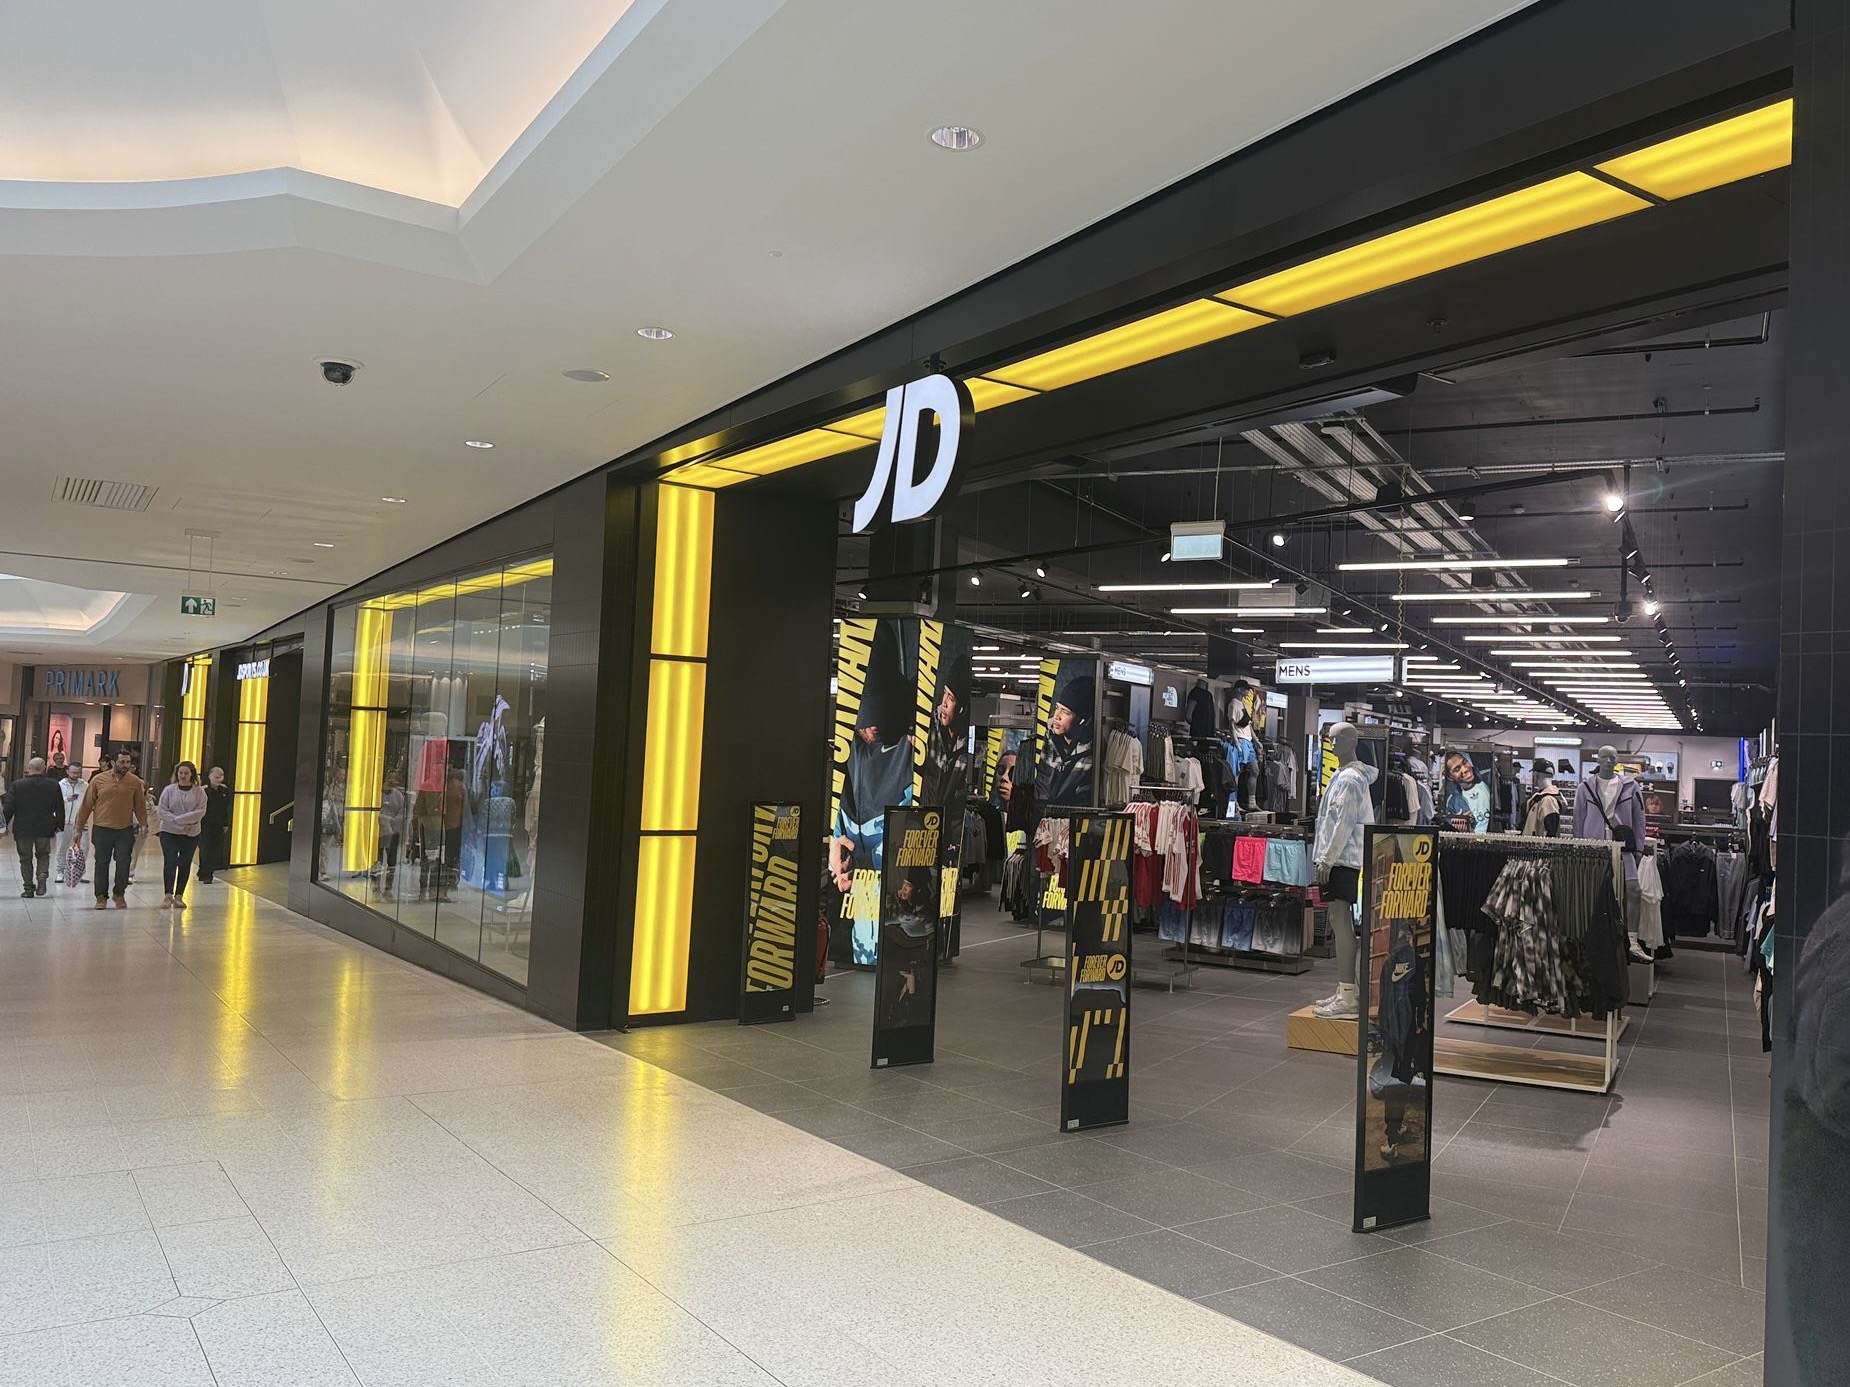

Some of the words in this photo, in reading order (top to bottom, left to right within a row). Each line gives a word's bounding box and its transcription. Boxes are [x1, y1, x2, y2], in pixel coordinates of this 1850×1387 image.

[852, 373, 961, 534] JD
[45, 670, 120, 697] PRIMARK
[1279, 665, 1311, 677] MENS
[903, 829, 940, 848] FOREVER
[895, 847, 937, 866] FORWARD
[1388, 862, 1432, 891] FOREVER
[1380, 890, 1429, 920] FORWARD
